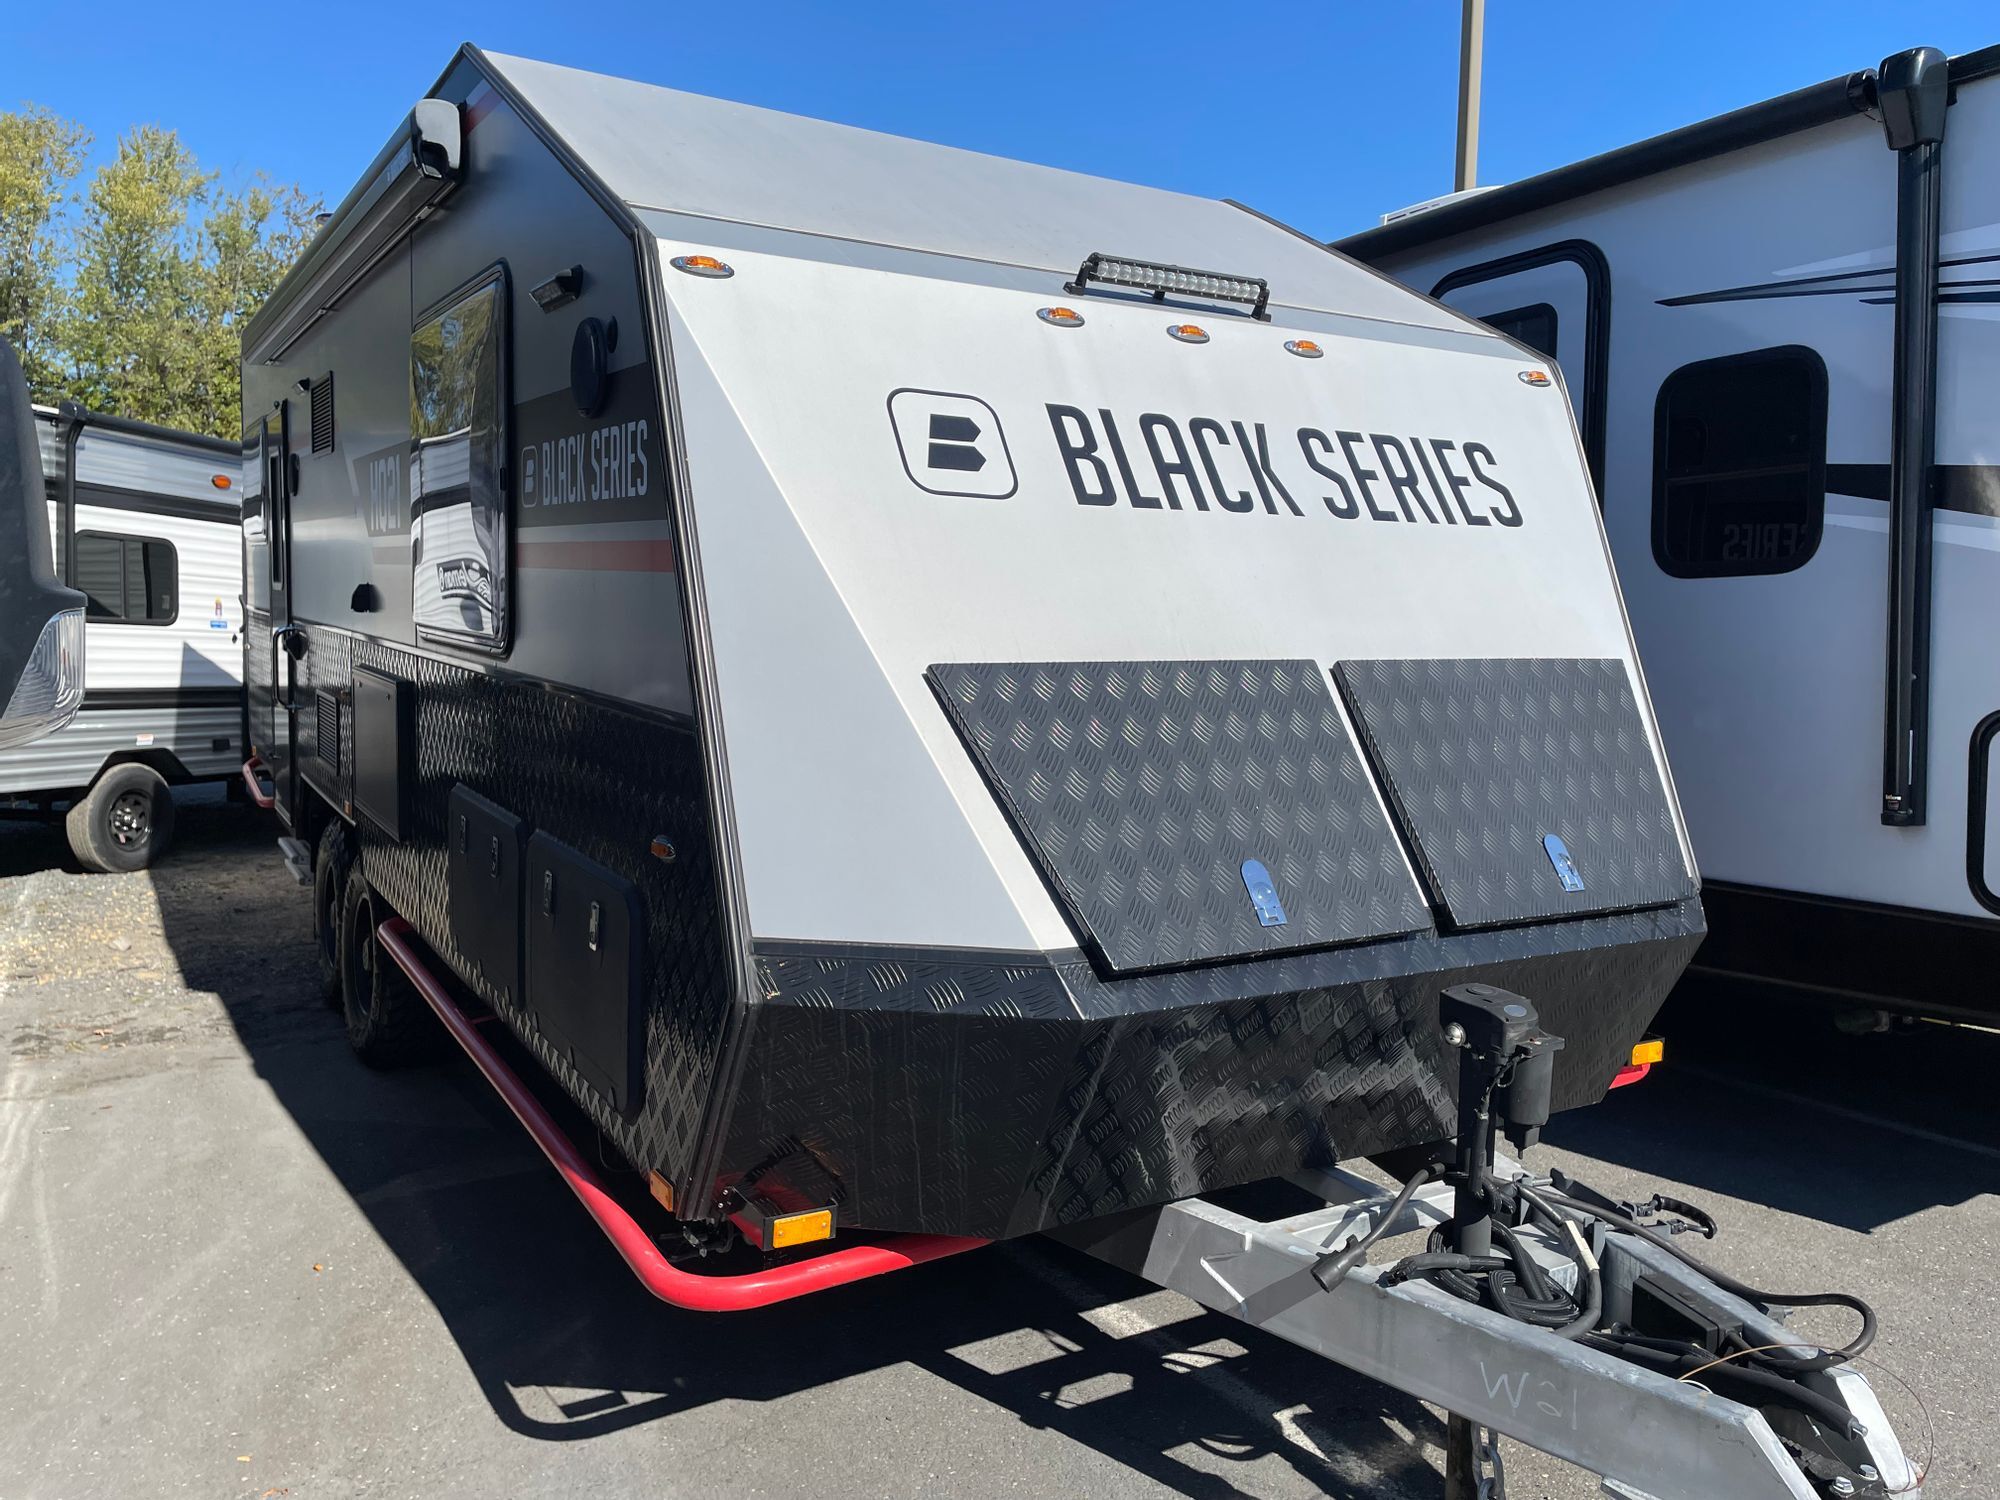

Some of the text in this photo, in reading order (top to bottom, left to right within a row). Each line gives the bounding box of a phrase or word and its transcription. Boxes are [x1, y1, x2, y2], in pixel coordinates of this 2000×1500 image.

[542, 419, 648, 506] BLACK SERIES
[1045, 403, 1524, 528] BLACK SERIES
